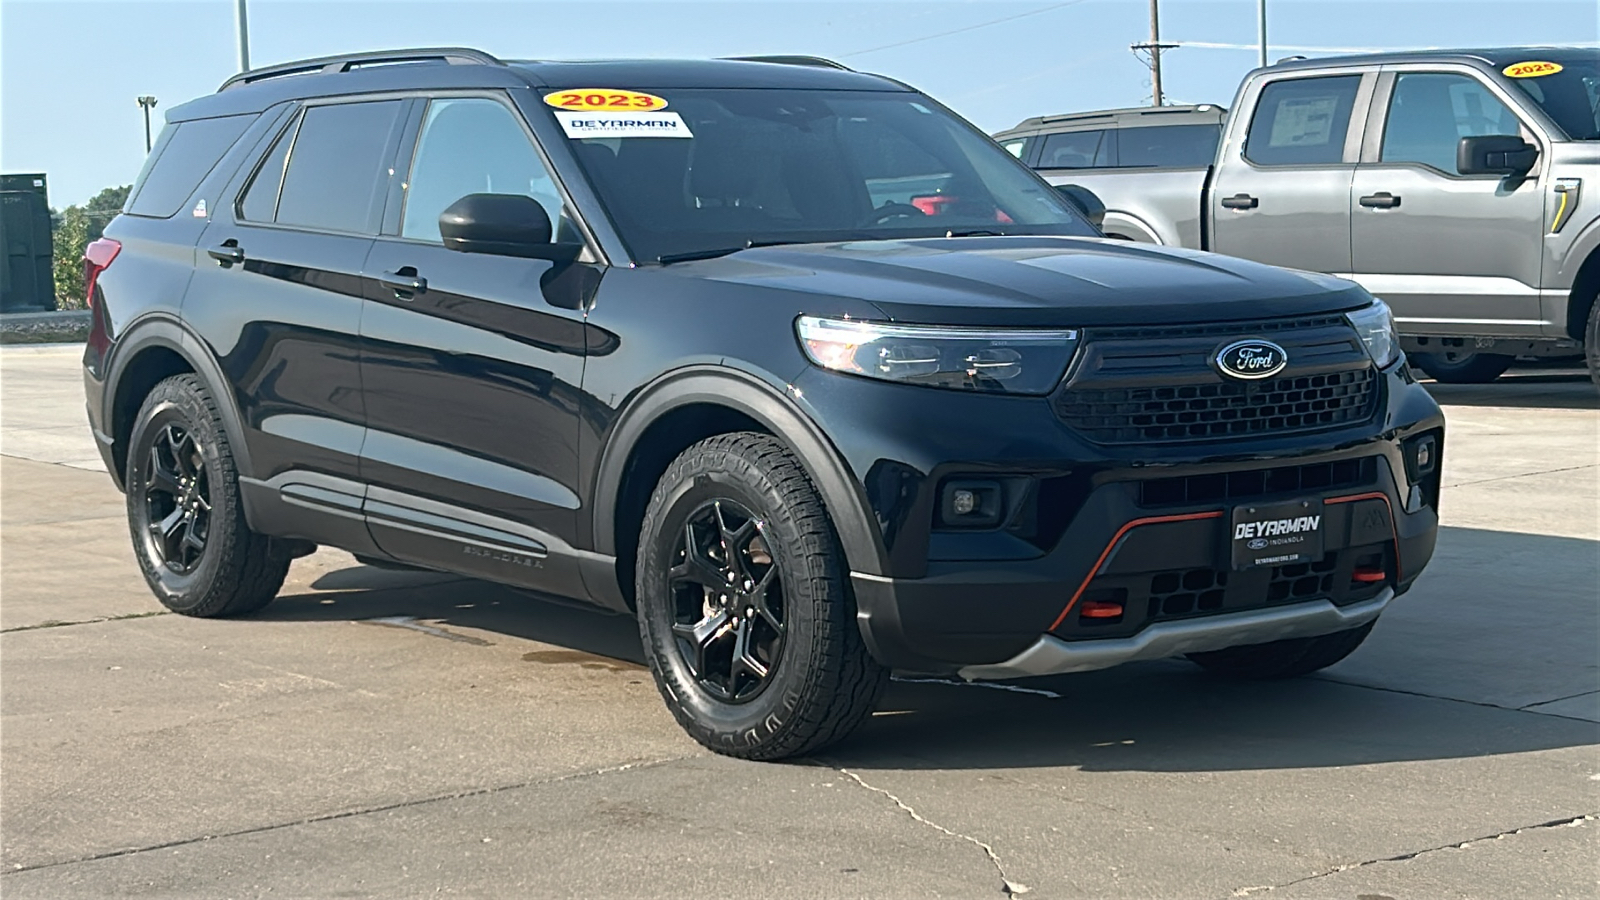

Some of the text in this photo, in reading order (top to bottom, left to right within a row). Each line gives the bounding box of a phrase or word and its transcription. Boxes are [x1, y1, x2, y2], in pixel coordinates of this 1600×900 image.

[1511, 63, 1555, 75] 2025
[561, 94, 654, 107] 2023
[1236, 347, 1274, 370] Ford
[1234, 515, 1320, 540] DEYARMAN
[1269, 536, 1304, 546] INDIANOLA
